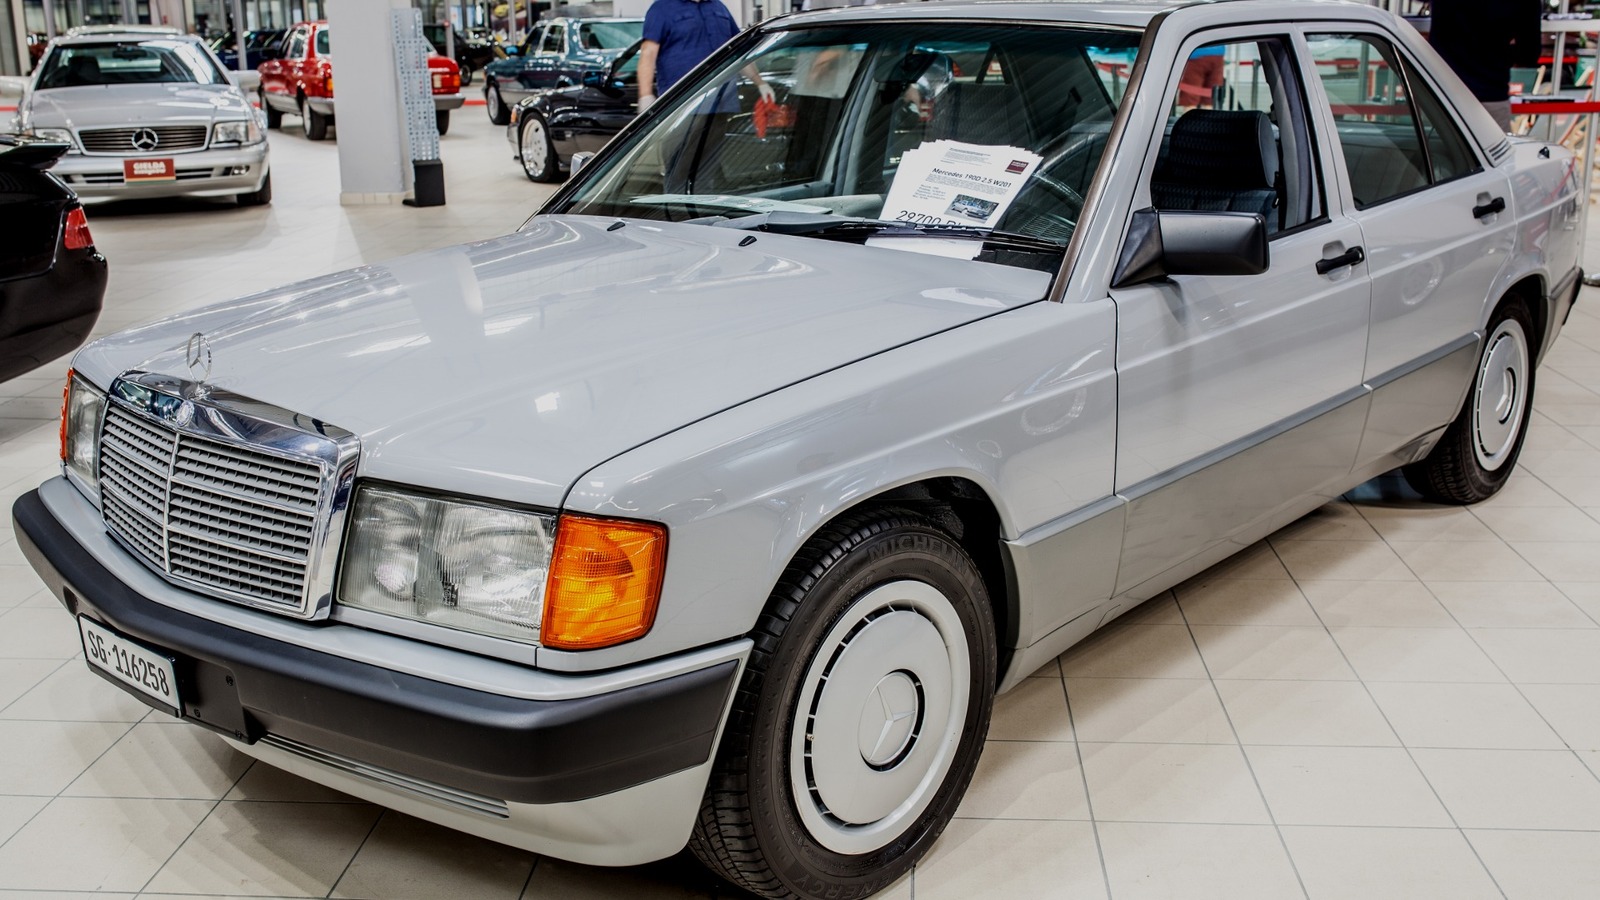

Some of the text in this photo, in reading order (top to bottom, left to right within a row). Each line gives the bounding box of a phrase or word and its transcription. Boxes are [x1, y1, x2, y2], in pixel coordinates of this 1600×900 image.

[932, 167, 962, 178] Mercedes
[964, 173, 980, 182] 190D
[993, 179, 1012, 188] W201
[867, 535, 969, 574] MICHELIN
[794, 873, 895, 900] ENERGY
